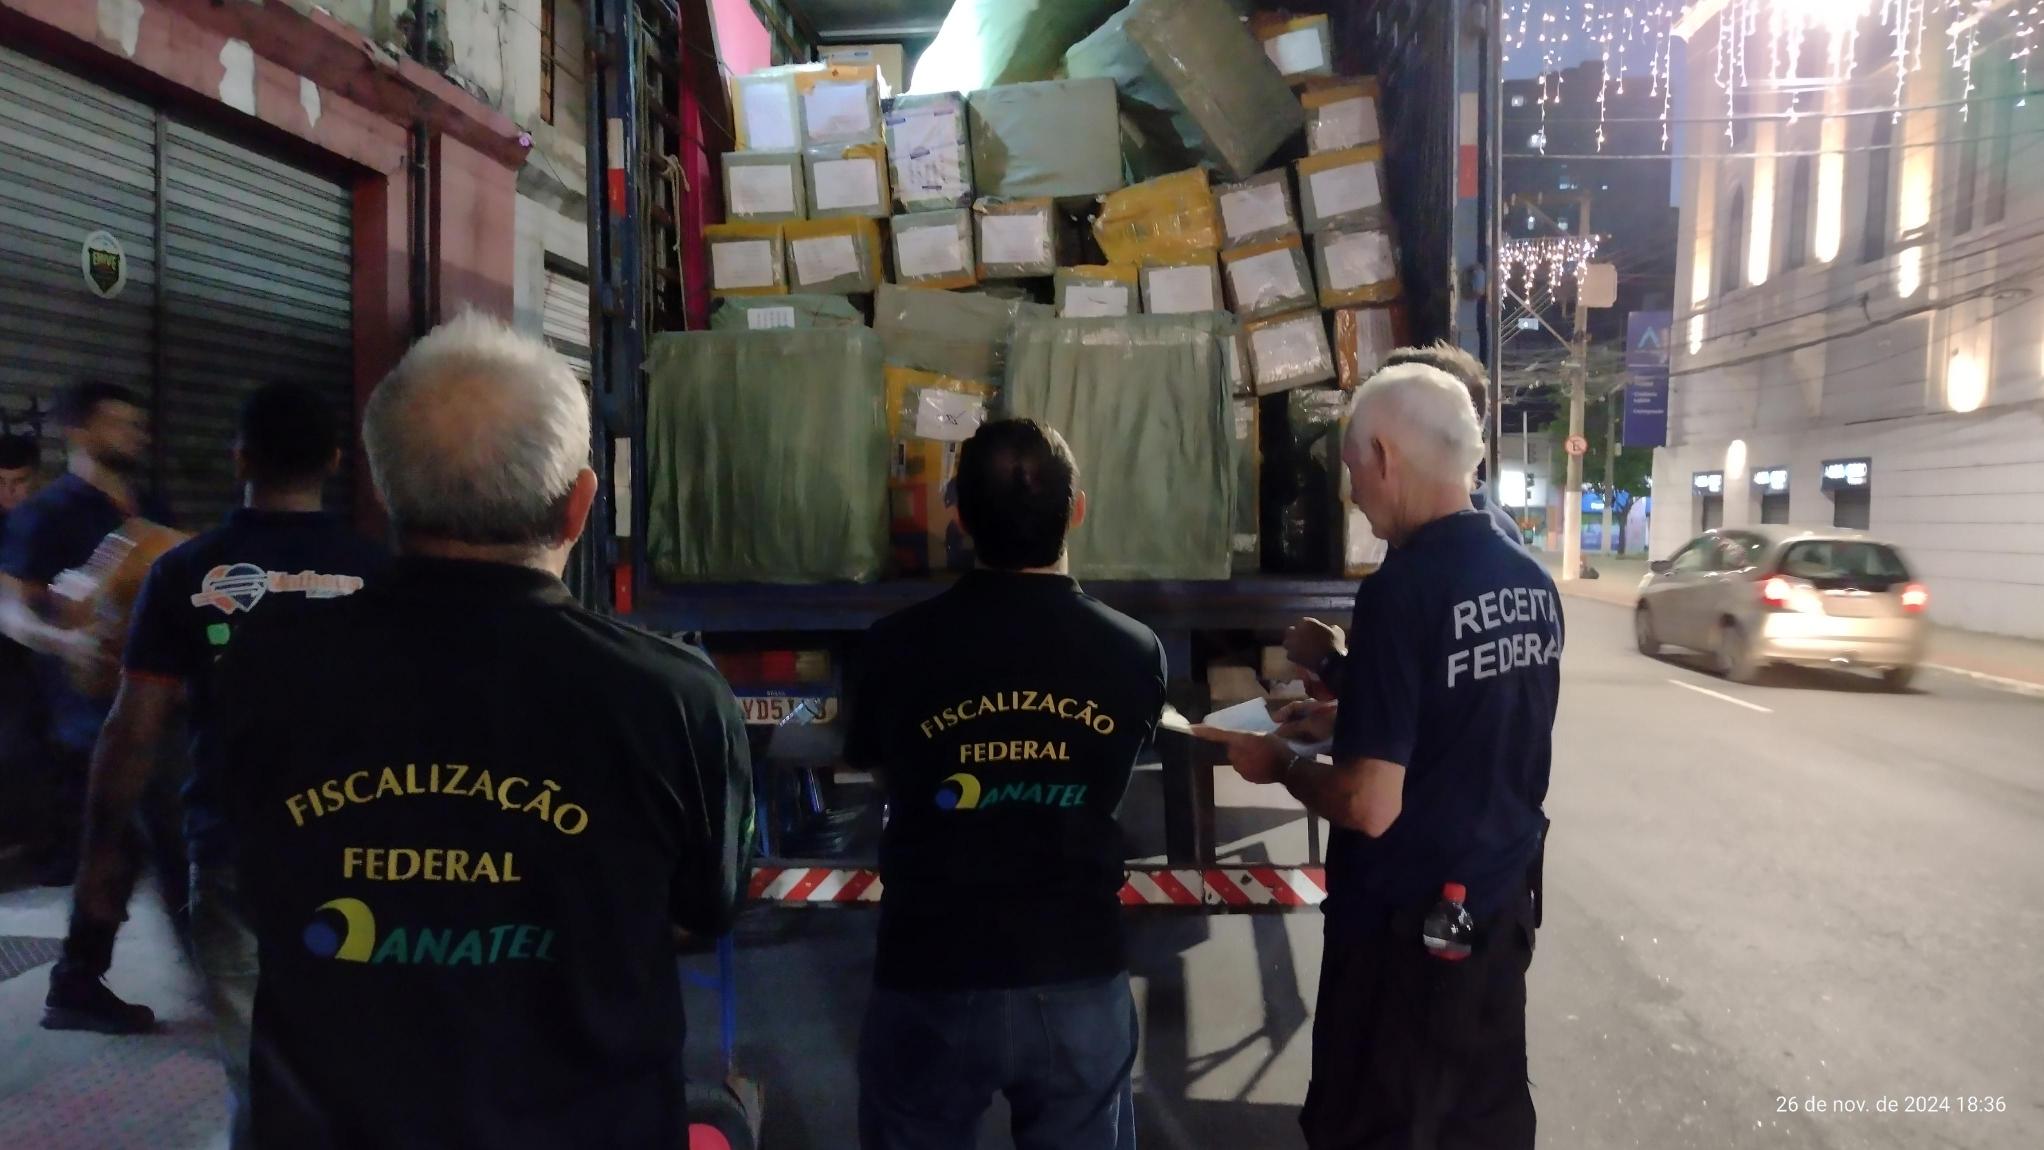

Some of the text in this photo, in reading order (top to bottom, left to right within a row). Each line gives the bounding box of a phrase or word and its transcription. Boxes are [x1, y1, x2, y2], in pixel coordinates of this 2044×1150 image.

[1453, 588, 1558, 640] RECEITA
[1447, 633, 1561, 688] FEDERA
[920, 691, 1115, 739] FISCALIZAÇÃO
[960, 740, 1070, 764] FEDERAL
[285, 763, 589, 835] FISCALIZAÇÃO
[980, 781, 1088, 809] ANATEL
[343, 847, 522, 883] FEDERAL
[371, 924, 558, 966] ANATEL
